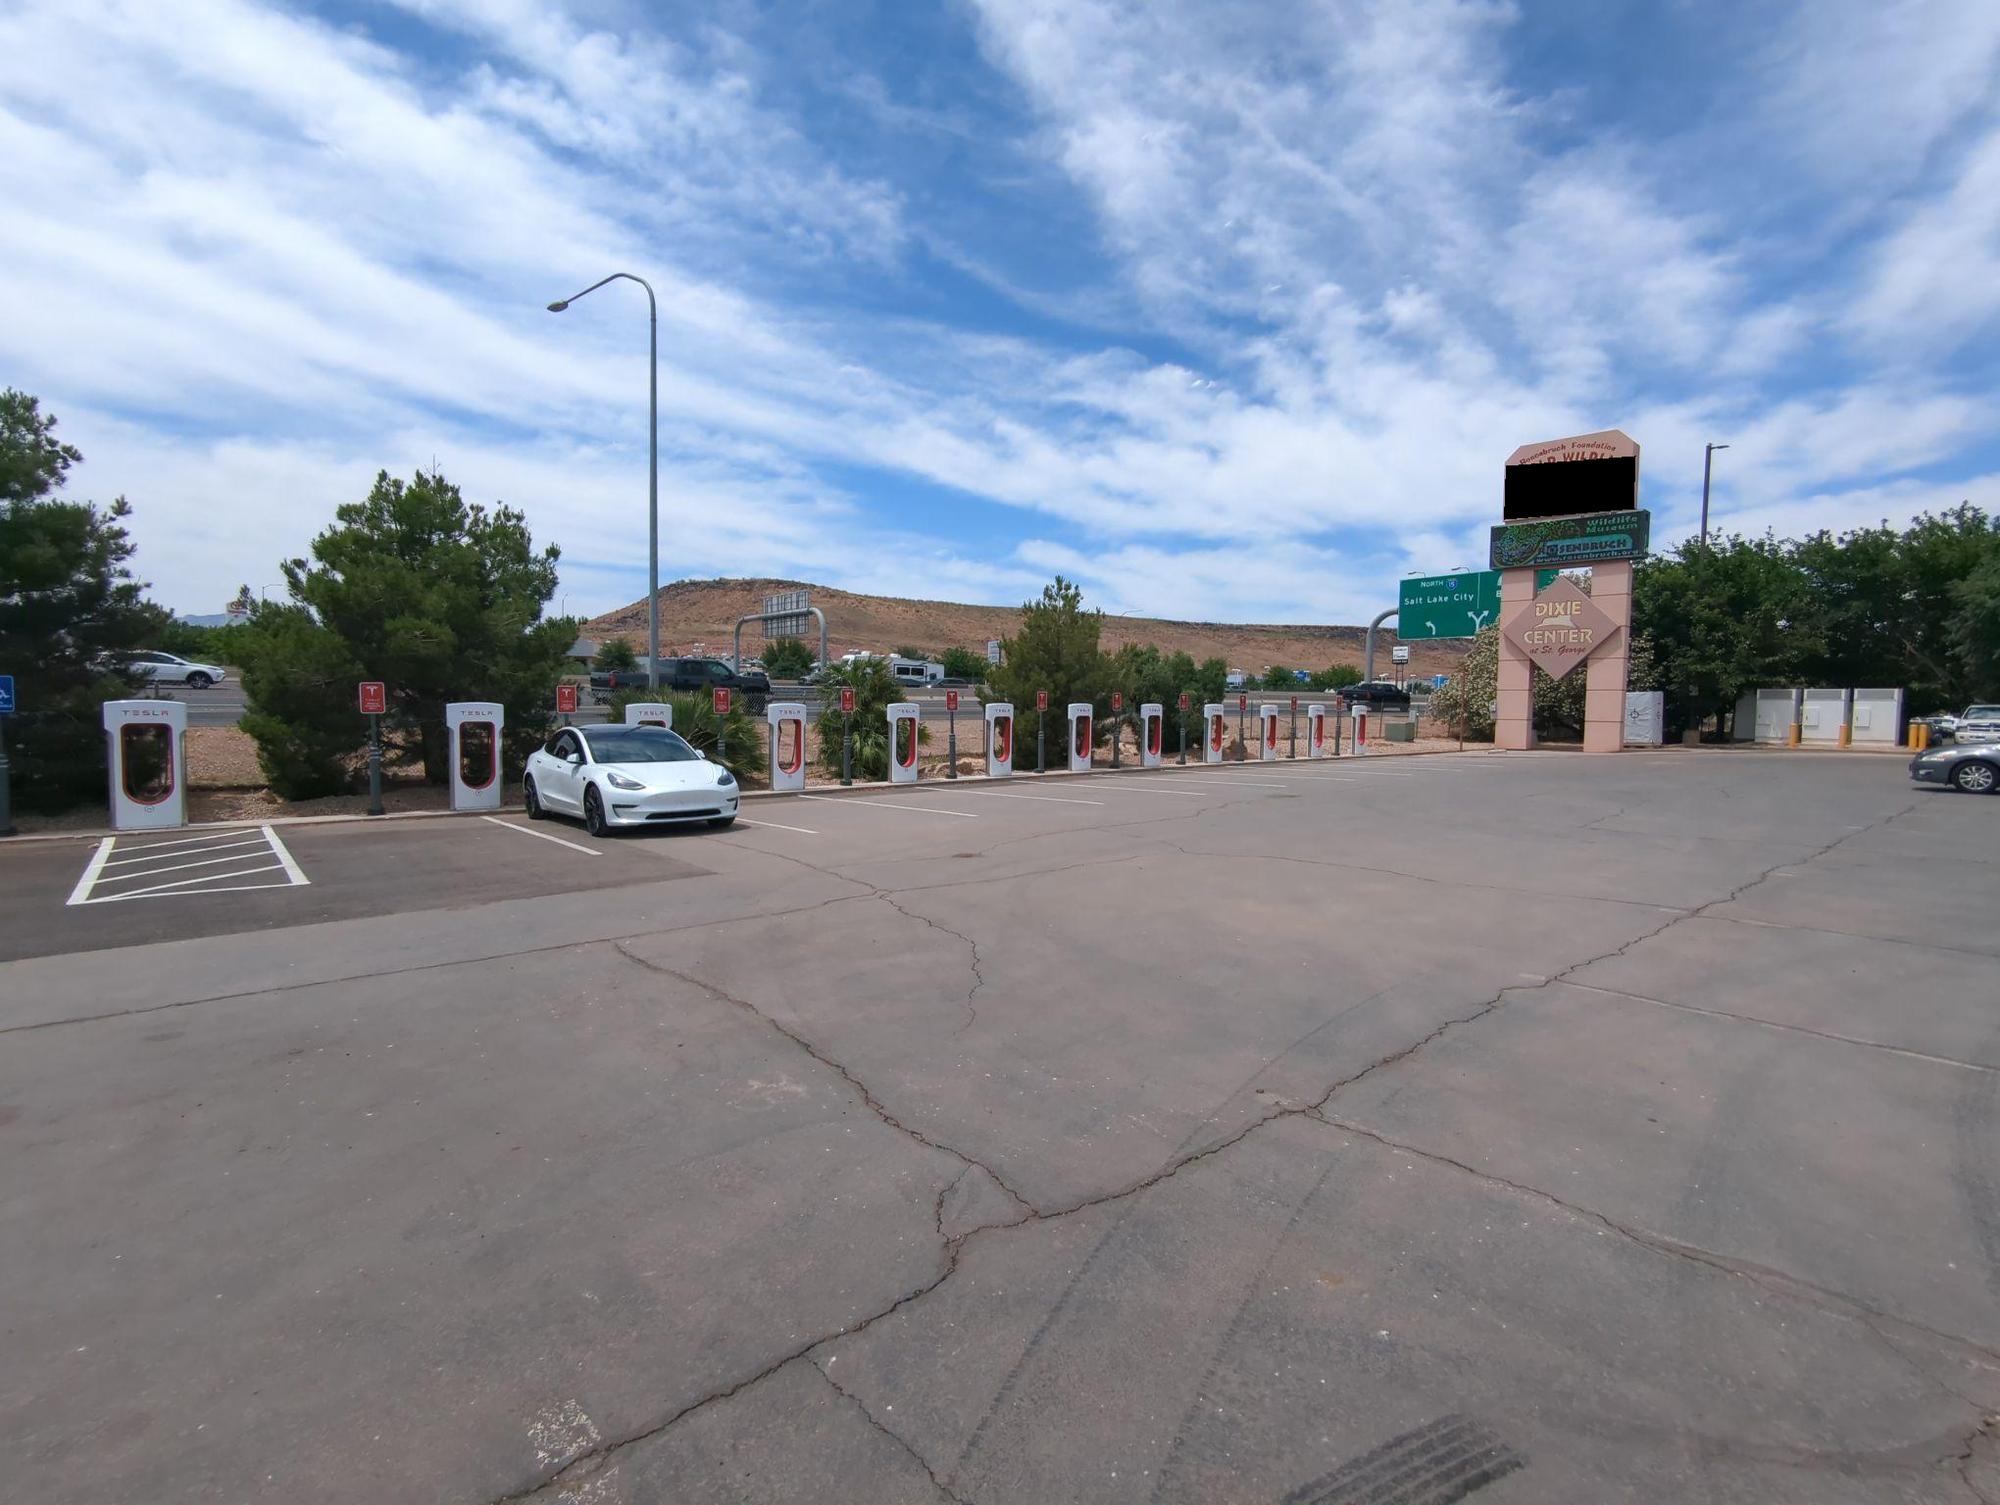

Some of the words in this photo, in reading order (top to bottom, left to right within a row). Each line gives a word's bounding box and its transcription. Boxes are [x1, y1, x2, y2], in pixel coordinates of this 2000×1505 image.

[1571, 441, 1617, 452] Foundation
[1587, 515, 1638, 527] Wildlife
[1586, 523, 1638, 534] Museum
[1540, 539, 1627, 555] ROSENBRUCH
[1420, 580, 1444, 588] NORTH
[1404, 598, 1423, 606] Salt
[1427, 595, 1449, 603] Lake
[1453, 593, 1475, 602] City
[1535, 601, 1582, 617] DIXIE
[1523, 628, 1593, 644] CENTER
[1557, 645, 1586, 656] George
